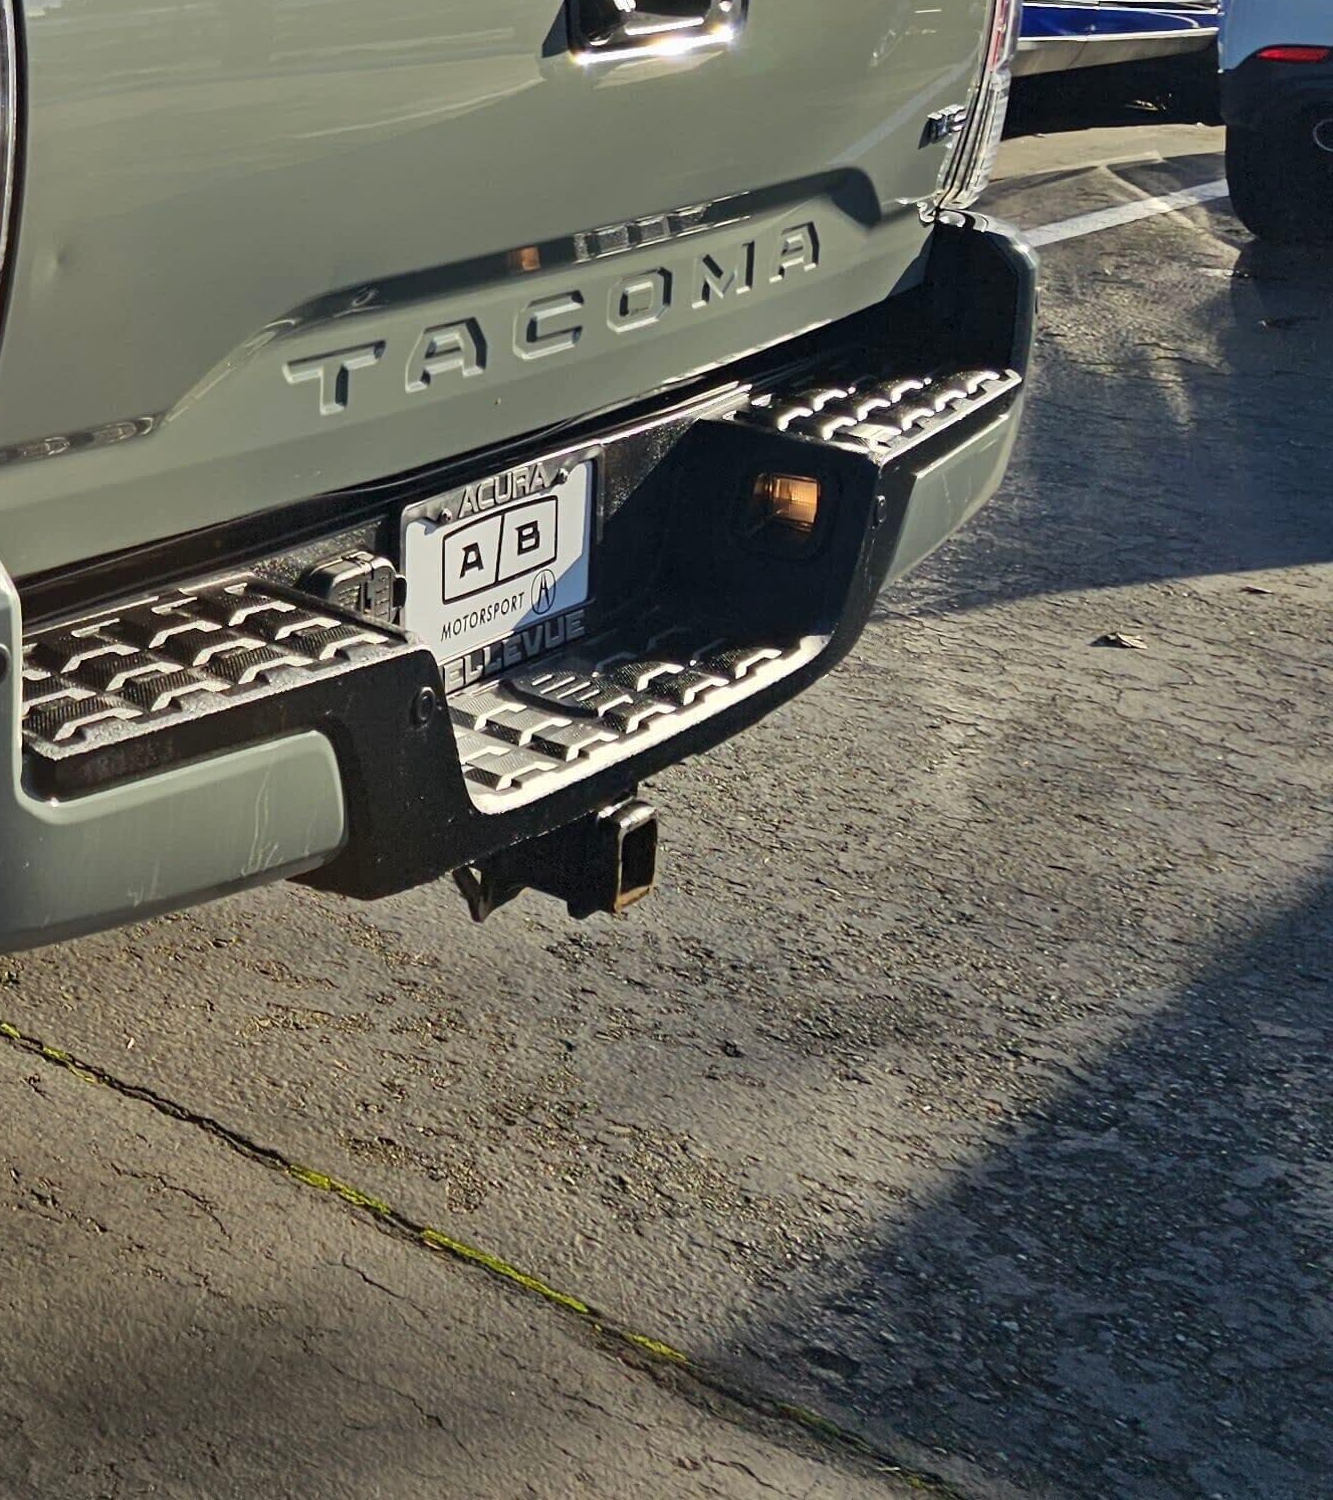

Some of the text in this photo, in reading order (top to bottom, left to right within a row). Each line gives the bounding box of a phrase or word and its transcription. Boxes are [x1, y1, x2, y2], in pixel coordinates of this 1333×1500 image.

[282, 220, 820, 416] TACOMA
[459, 461, 552, 519] ACURA
[459, 520, 541, 579] A B
[440, 591, 525, 642] MOTORSPORT
[443, 609, 585, 695] ELLEVUE
